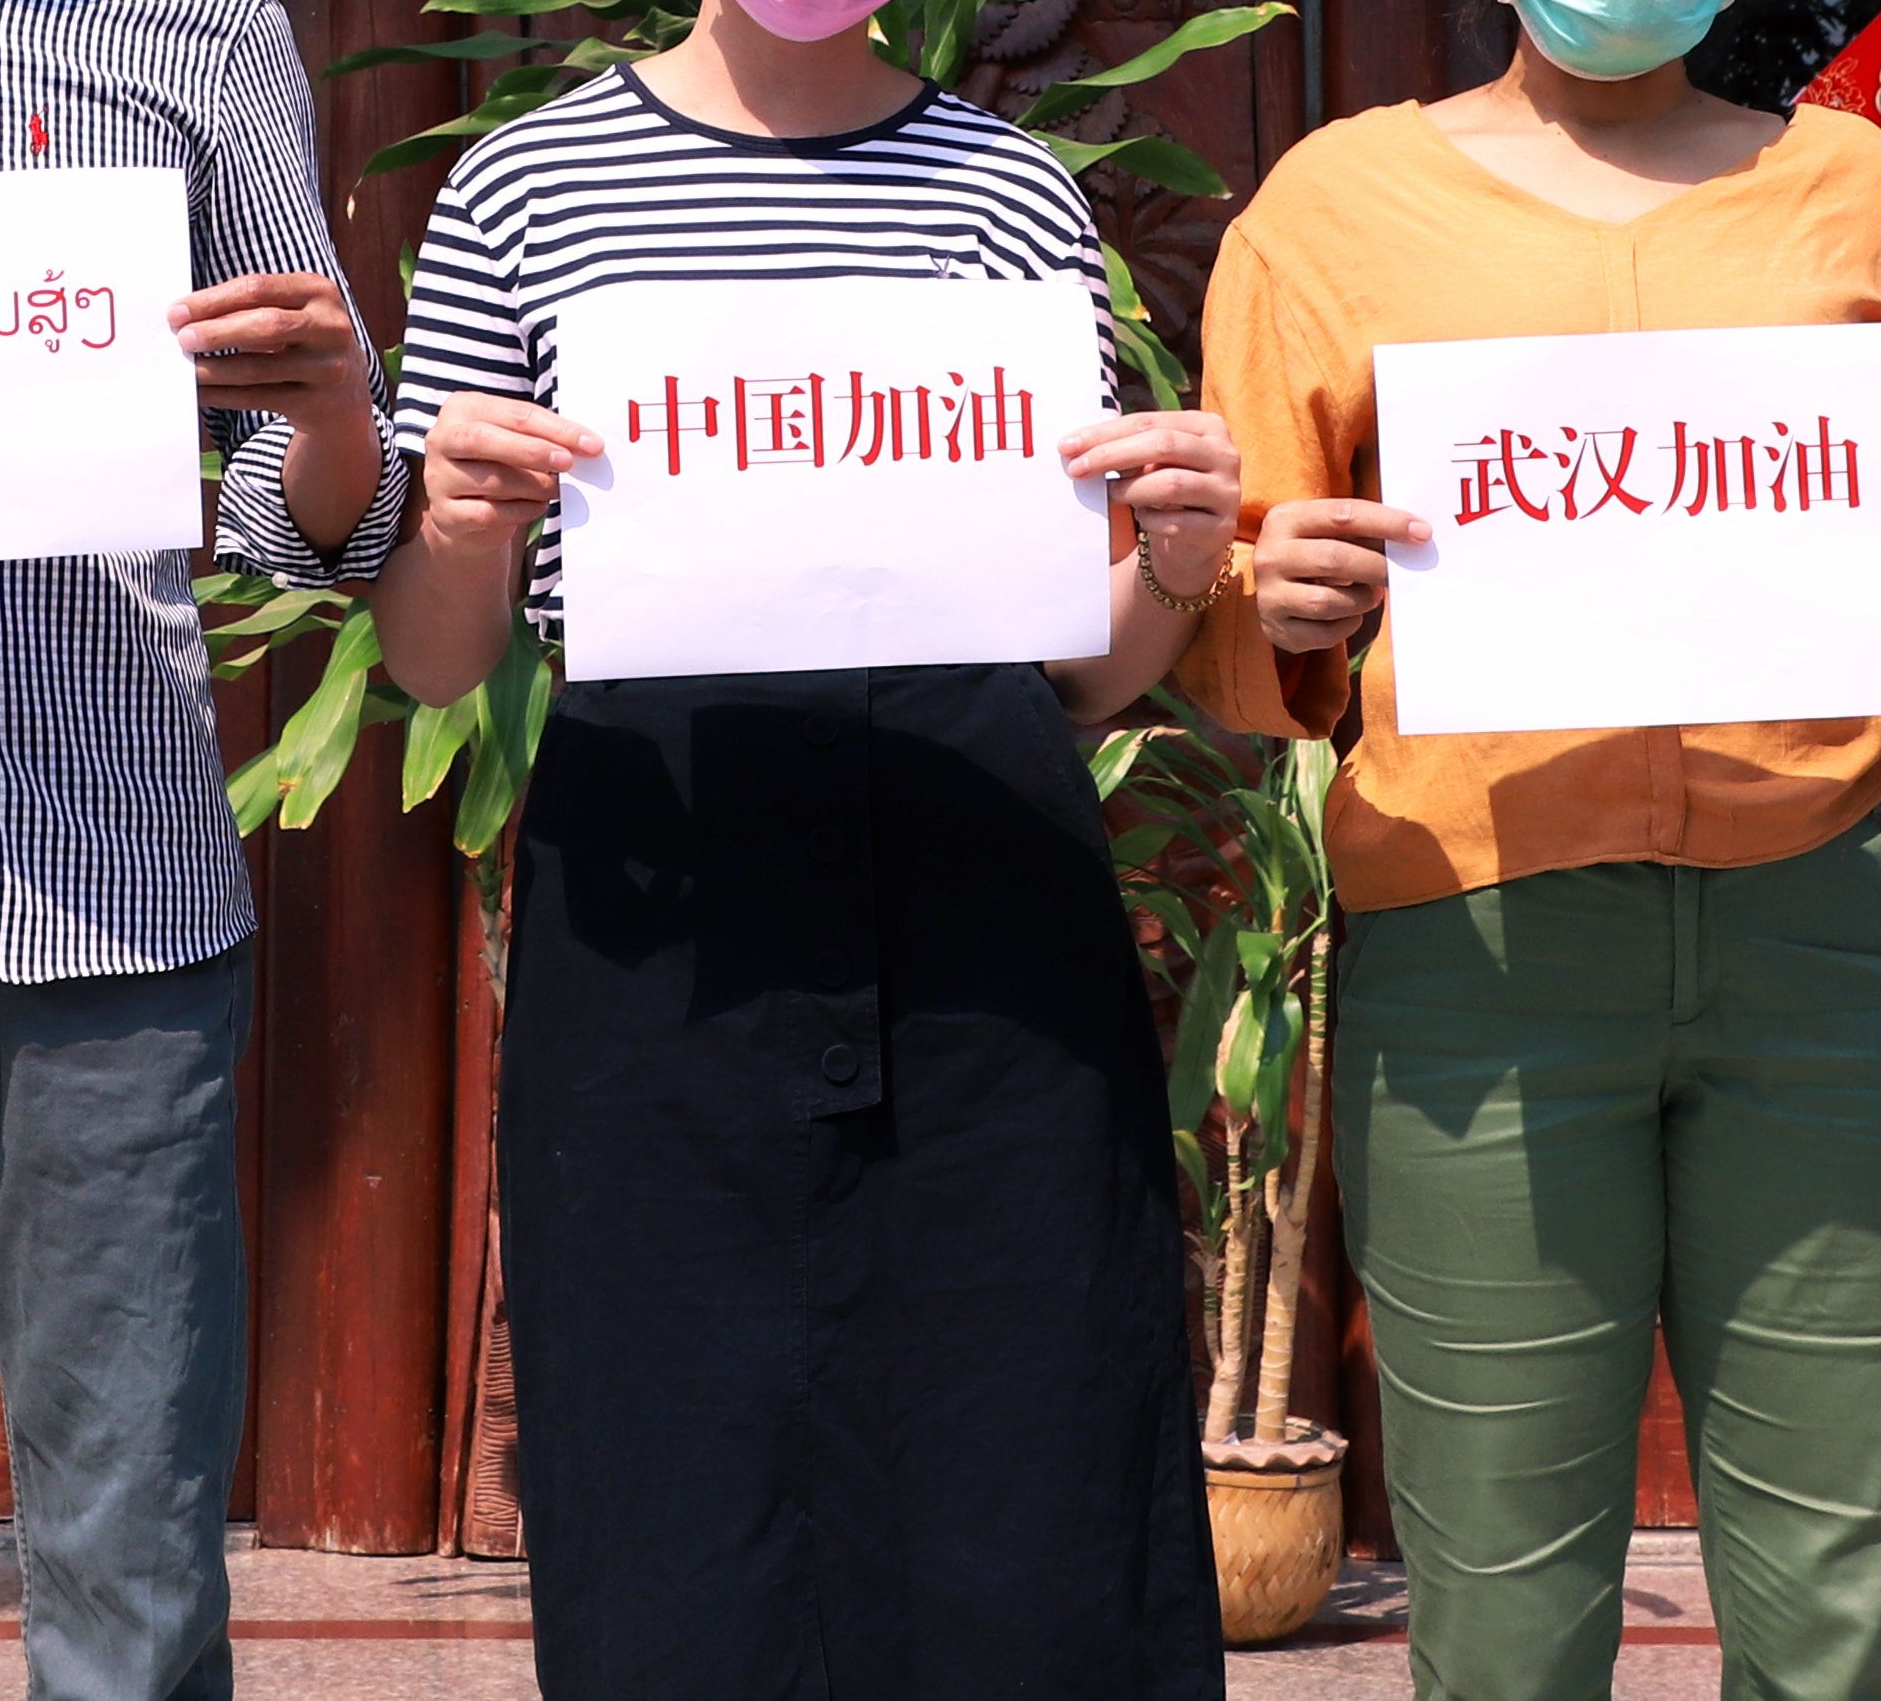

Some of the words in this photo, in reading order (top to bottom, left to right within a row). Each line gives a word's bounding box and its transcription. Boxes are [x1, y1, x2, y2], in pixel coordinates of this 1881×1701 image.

[627, 365, 1035, 476] 中国加油
[1451, 415, 1861, 527] 武汉加油
